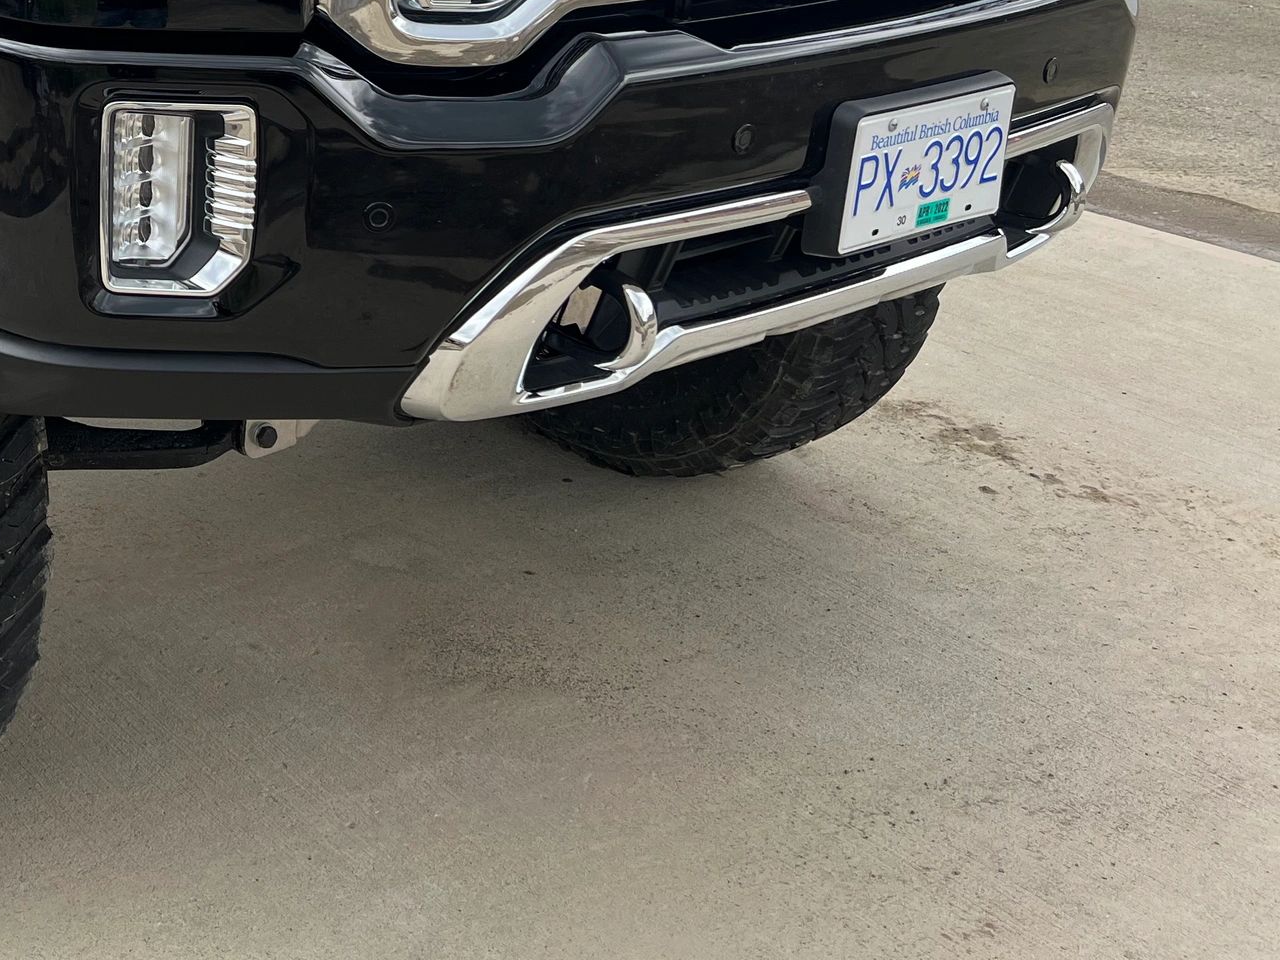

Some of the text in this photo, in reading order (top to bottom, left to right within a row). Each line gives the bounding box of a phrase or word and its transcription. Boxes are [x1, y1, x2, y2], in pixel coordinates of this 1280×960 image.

[871, 109, 999, 151] Beautiful British Columbia
[853, 127, 1003, 217] PX 3392
[897, 215, 906, 226] 30
